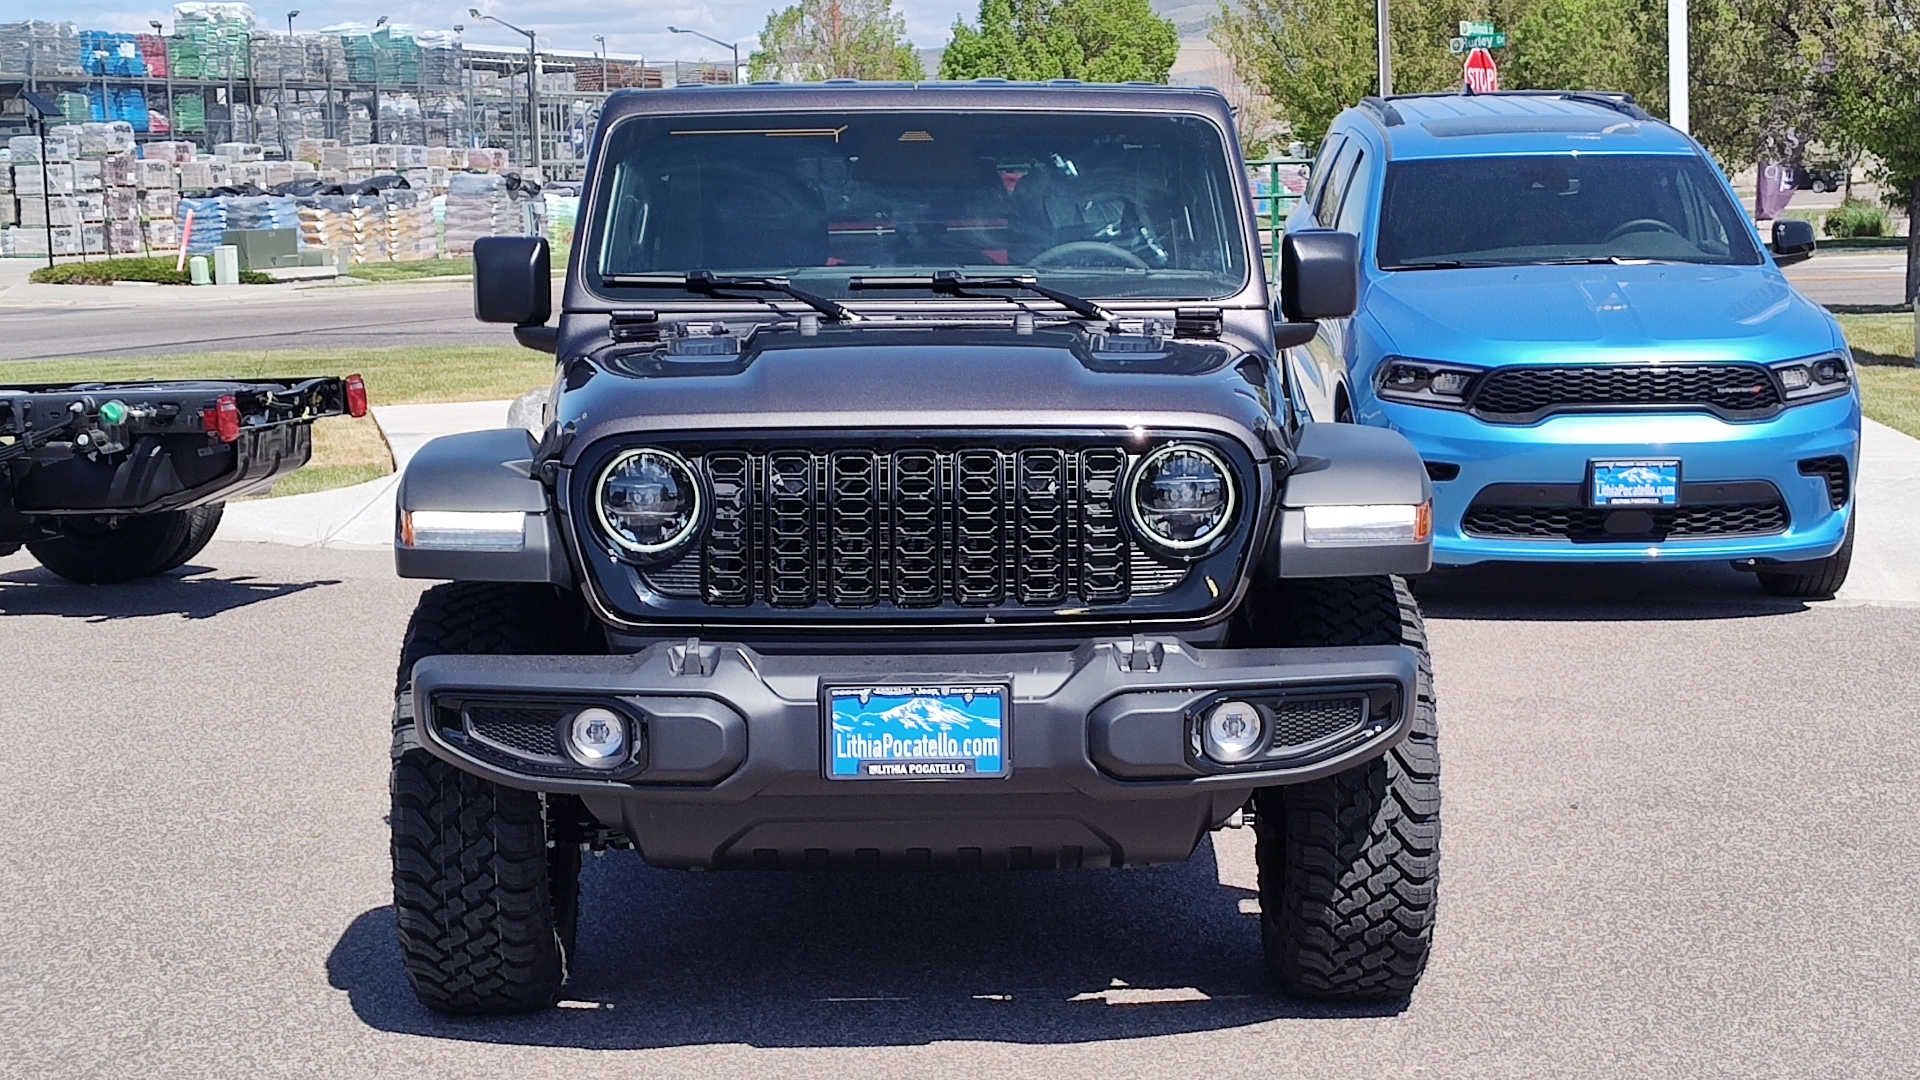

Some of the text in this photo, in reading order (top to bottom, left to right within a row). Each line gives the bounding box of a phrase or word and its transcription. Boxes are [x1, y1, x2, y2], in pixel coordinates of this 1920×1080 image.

[1467, 67, 1494, 92] STOP
[571, 128, 583, 144] 5
[836, 732, 998, 758] LithiaPocatello.com
[876, 763, 966, 774] LITHIA POCATELLO
